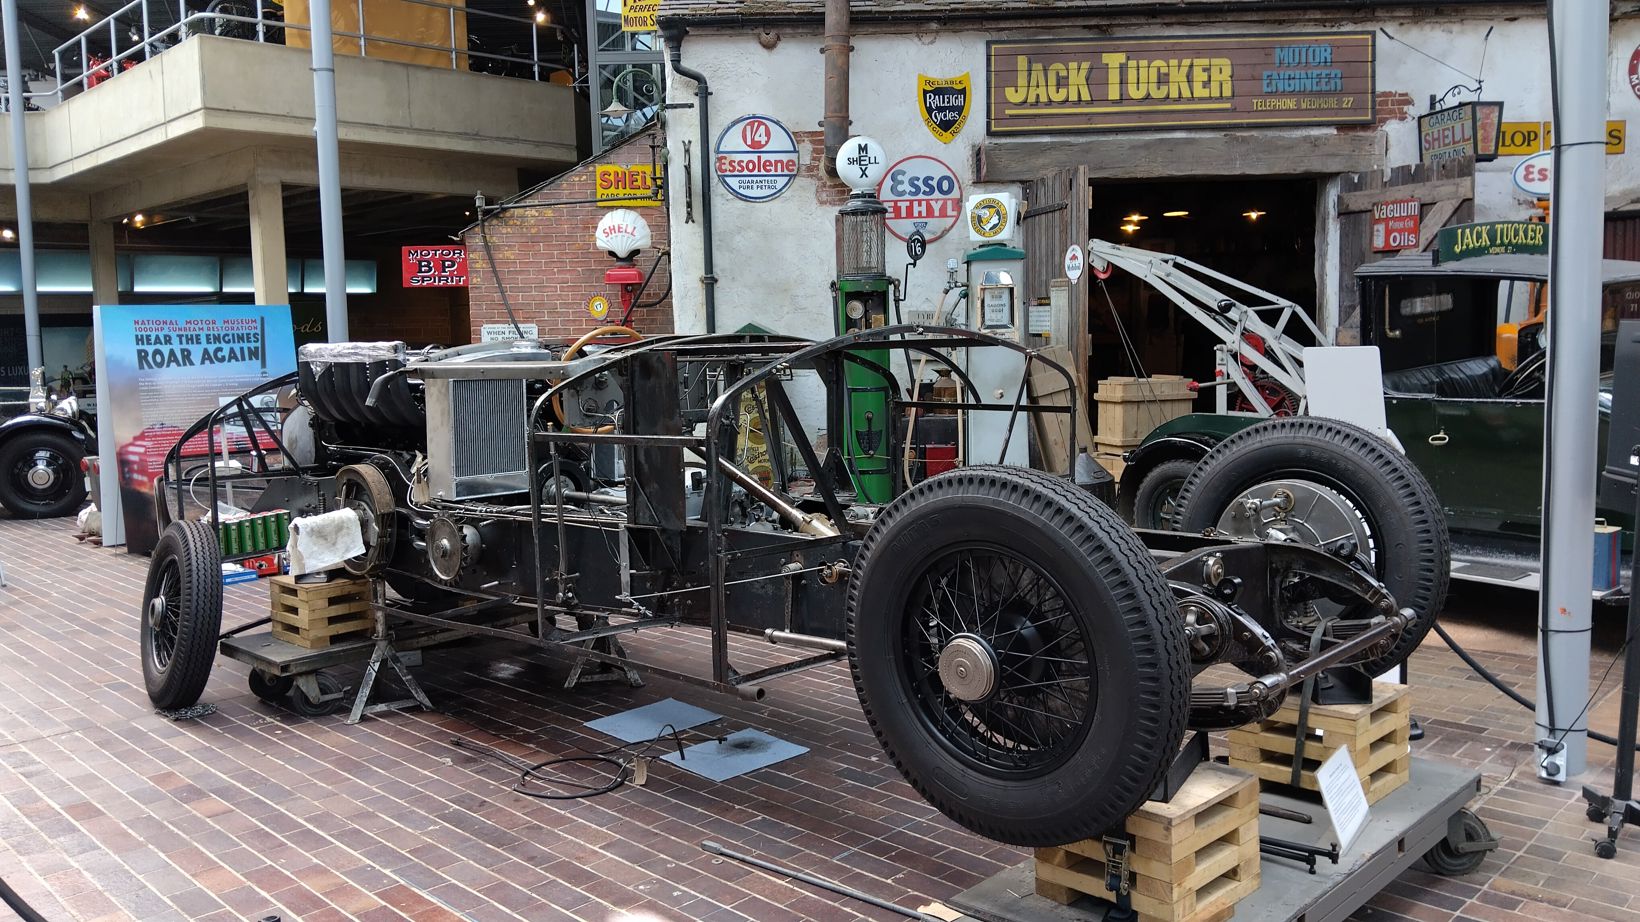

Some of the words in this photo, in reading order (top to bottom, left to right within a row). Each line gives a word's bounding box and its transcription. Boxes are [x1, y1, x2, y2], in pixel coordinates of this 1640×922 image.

[629, 4, 658, 12] PERFEC
[624, 16, 648, 27] MOTOR
[650, 14, 658, 26] S
[1275, 44, 1332, 67] MOTOR
[924, 79, 964, 88] RELIABLE
[1004, 55, 1092, 103] JACK
[1102, 52, 1232, 101] TUCKER
[1263, 69, 1343, 93] ENGINEER
[926, 93, 964, 109] RALEIGH
[1252, 99, 1297, 111] TELEPHONE
[1301, 97, 1338, 108] WEDMORE
[1342, 97, 1354, 108] 27
[931, 109, 960, 124] Cycles
[1428, 108, 1464, 128] GARAGE
[925, 117, 944, 137] RIGID
[949, 114, 966, 137] RAPID
[1423, 122, 1472, 152] SHELL
[716, 155, 796, 174] Essolene
[847, 155, 880, 166] SHELL
[599, 170, 654, 190] SHEL
[886, 199, 958, 219] ETHYL
[1374, 201, 1418, 219] Vacuum
[603, 224, 637, 238] SHELL
[1390, 231, 1416, 247] Oils
[1454, 226, 1491, 254] JACK
[1495, 224, 1544, 246] TUCKER
[408, 249, 466, 259] MOTOR
[410, 275, 466, 285] SPIRIT
[135, 334, 173, 346] HEAR
[176, 333, 202, 345] THE
[205, 332, 260, 345] ENGINES
[136, 347, 196, 371] ROAR
